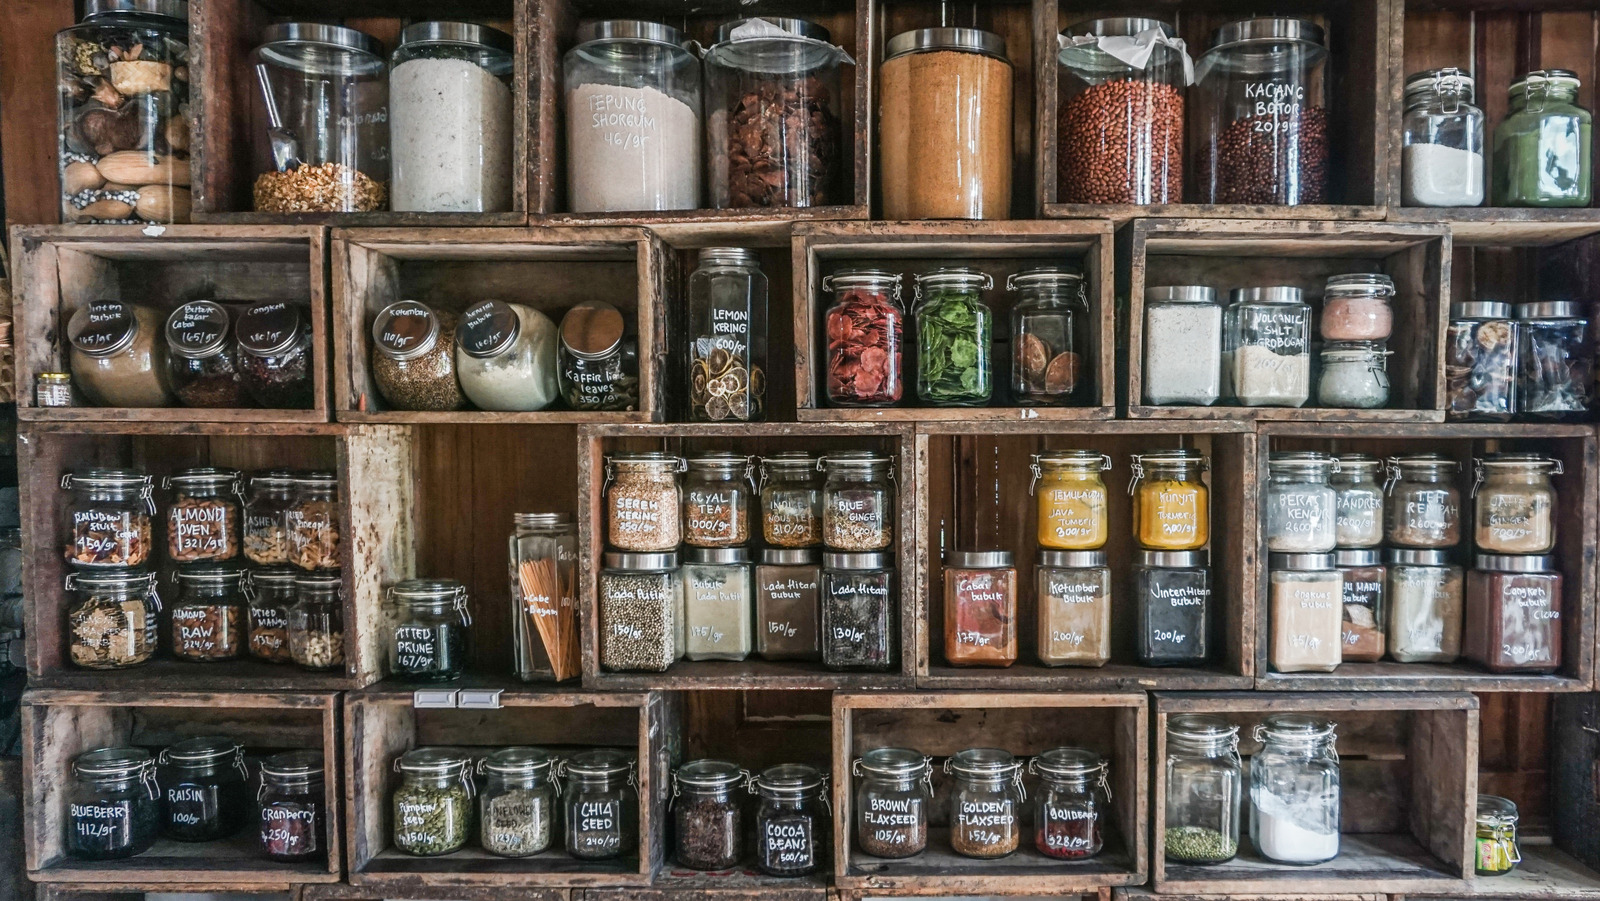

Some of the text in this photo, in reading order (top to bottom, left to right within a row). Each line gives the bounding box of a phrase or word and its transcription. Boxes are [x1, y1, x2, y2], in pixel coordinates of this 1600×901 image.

[1245, 82, 1304, 100] KACANG
[587, 94, 647, 113] TEPUNG
[1256, 101, 1300, 117] BOTOR
[592, 114, 656, 130] SHORGUM
[604, 132, 649, 150] 46/gr
[713, 308, 748, 321] LEMON
[713, 322, 747, 334] KERING
[716, 338, 746, 355] 600/gr
[581, 384, 614, 394] leaves
[616, 497, 658, 510] SEREH
[839, 501, 863, 511] BLUE
[1280, 493, 1321, 507] BERAS
[170, 506, 225, 522] ALMOND
[698, 504, 722, 514] TEA
[1048, 508, 1074, 518] JAVA
[246, 515, 280, 527] ASHEW
[849, 512, 882, 521] GINGER
[179, 524, 210, 536] OVEN
[688, 518, 730, 532] 1000/gr
[1056, 527, 1092, 537] 300/gr
[831, 581, 856, 595] Lada
[182, 626, 213, 639] RAW
[614, 624, 643, 639] 150/gr
[769, 621, 797, 637] 150/gr
[833, 627, 865, 642] 130/gr
[1154, 629, 1186, 643] 200/gr
[957, 632, 990, 646] 175/gr
[1053, 631, 1084, 645] 200/gr
[398, 641, 434, 654] PRUNE
[1503, 644, 1540, 661] 200/gr
[398, 655, 433, 668] 167/gr
[168, 788, 203, 803] RAISIN
[581, 801, 613, 817] CHIA
[871, 798, 910, 813] BROWN
[963, 802, 1004, 813] GOLDEN
[173, 813, 200, 825] 100/gr
[582, 818, 612, 831] SEED
[865, 811, 917, 825] FLAXSEED
[959, 814, 1014, 826] FLAXSEED
[77, 822, 117, 837] 412/gr
[768, 824, 804, 837] COCOA
[586, 834, 619, 847] 240/gr
[875, 830, 906, 844] 105/gr
[969, 830, 1001, 844] 152/gr
[768, 838, 807, 851] BEANS
[781, 851, 809, 862] 500/gr
